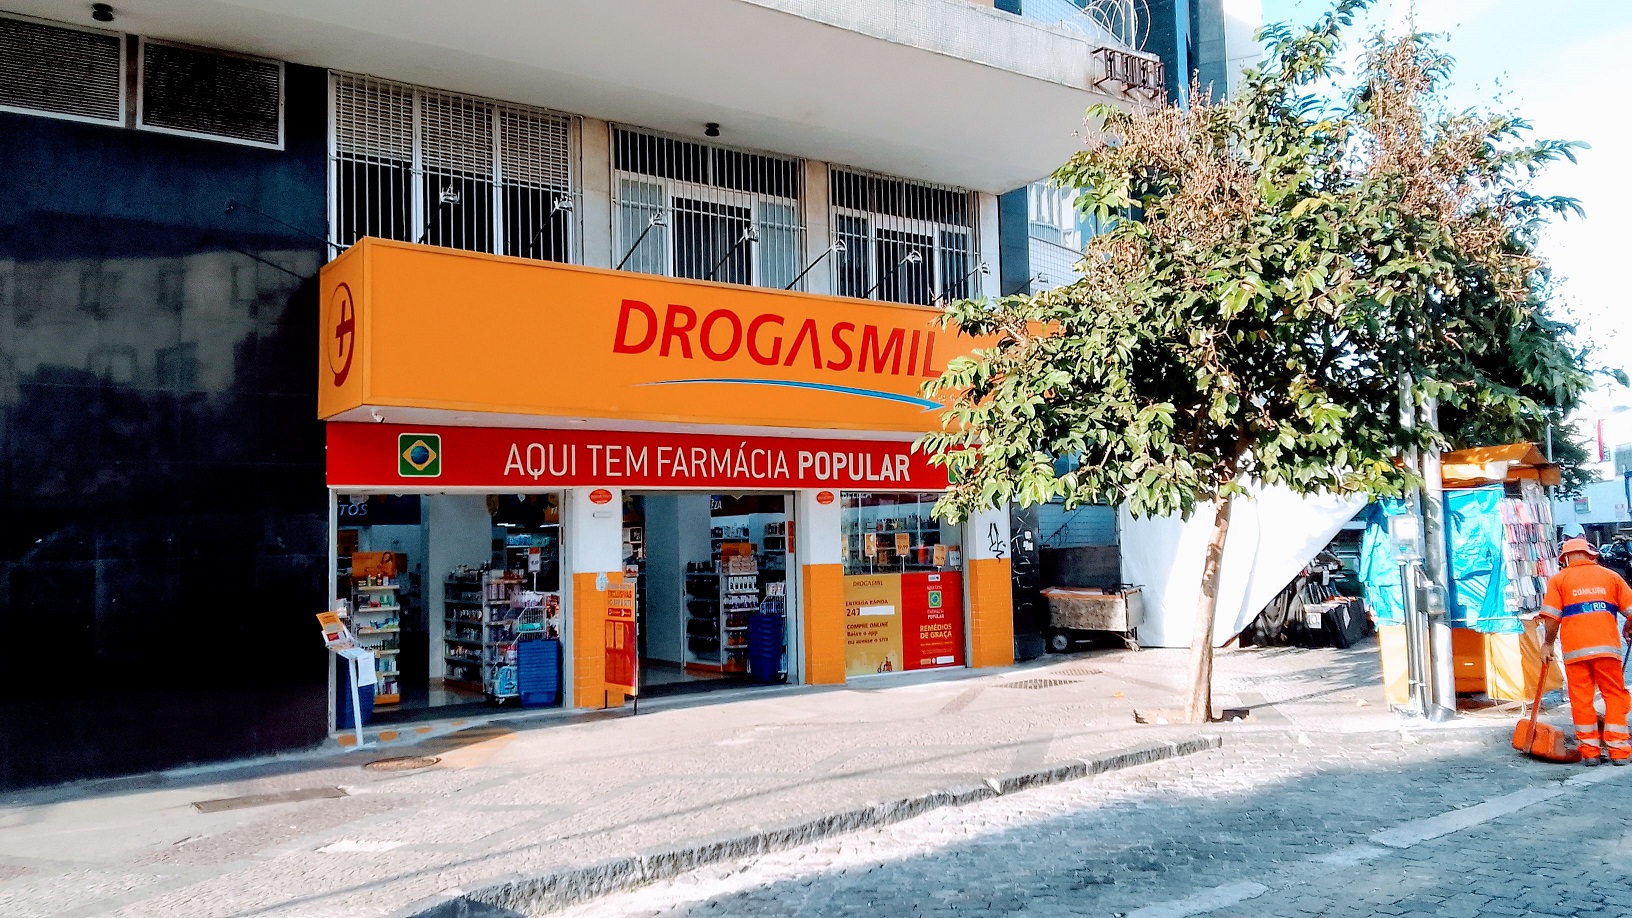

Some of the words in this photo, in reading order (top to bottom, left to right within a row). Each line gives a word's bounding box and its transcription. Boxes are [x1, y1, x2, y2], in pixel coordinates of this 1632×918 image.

[613, 299, 944, 378] DROGASMIL
[503, 443, 576, 481] AQUI
[587, 444, 648, 477] TEM
[657, 441, 790, 479] FARMÁCIA
[798, 450, 911, 482] POPULAR
[1593, 602, 1606, 610] RIO
[920, 623, 952, 632] REMÉDIOS
[930, 631, 952, 639] GRAÇA
